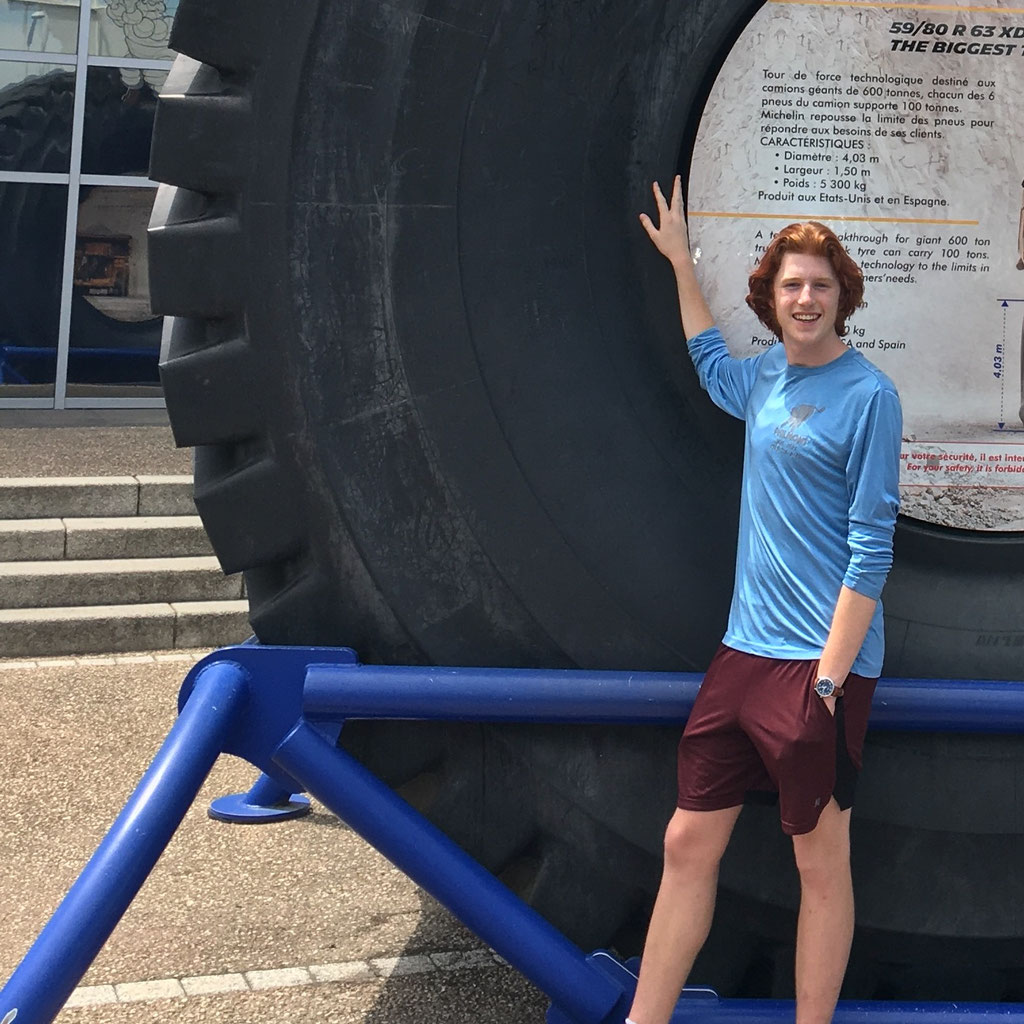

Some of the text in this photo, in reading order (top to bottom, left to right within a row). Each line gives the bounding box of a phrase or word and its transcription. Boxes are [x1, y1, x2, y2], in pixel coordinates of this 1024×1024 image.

[889, 21, 949, 37] 59/80
[952, 25, 966, 37] R
[970, 25, 996, 38] 63
[891, 39, 929, 53] THE
[931, 41, 1016, 56] BIGGEST
[763, 69, 996, 88] Tour de force technologique destiné aux
[762, 84, 995, 101] camions géants de 600 tonnes, chacun des 6
[761, 97, 962, 113] pneus du camion supporte 100 tonnes.
[760, 110, 995, 129] Michelin repousse la limite des pneus pour
[760, 124, 945, 139] répondre aux besoins de ses clients.
[760, 136, 864, 150] CARACTÉRISTIQUES
[784, 151, 832, 163] Diamètre
[842, 153, 866, 164] 4,03
[870, 155, 880, 164] m
[783, 165, 823, 177] Largeur
[834, 166, 858, 177] 1,50
[861, 168, 871, 177] m
[783, 178, 810, 189] Poids
[820, 179, 827, 189] 5
[830, 179, 850, 190] 300
[854, 180, 867, 192] kg
[758, 191, 950, 208] Produit aux Etats-Unis et en Espagne.
[754, 230, 763, 239] A
[838, 231, 888, 245] akthrough
[895, 233, 910, 244] for
[916, 235, 942, 246] giant
[948, 236, 968, 246] 600
[974, 237, 990, 246] ton
[857, 247, 876, 257] tyre
[883, 249, 901, 257] can
[908, 249, 933, 260] carry
[941, 248, 960, 258] 100
[966, 250, 990, 260] tons.
[860, 260, 990, 272] technology to the limits in
[853, 326, 866, 337] kg
[856, 339, 875, 349] and
[878, 339, 906, 351] Spain
[995, 343, 1003, 354] m
[911, 452, 937, 461] votre
[980, 453, 986, 462] il
[988, 454, 1003, 463] est
[906, 462, 921, 471] For
[923, 464, 943, 474] your
[976, 463, 985, 473] it
[985, 464, 993, 473] is
